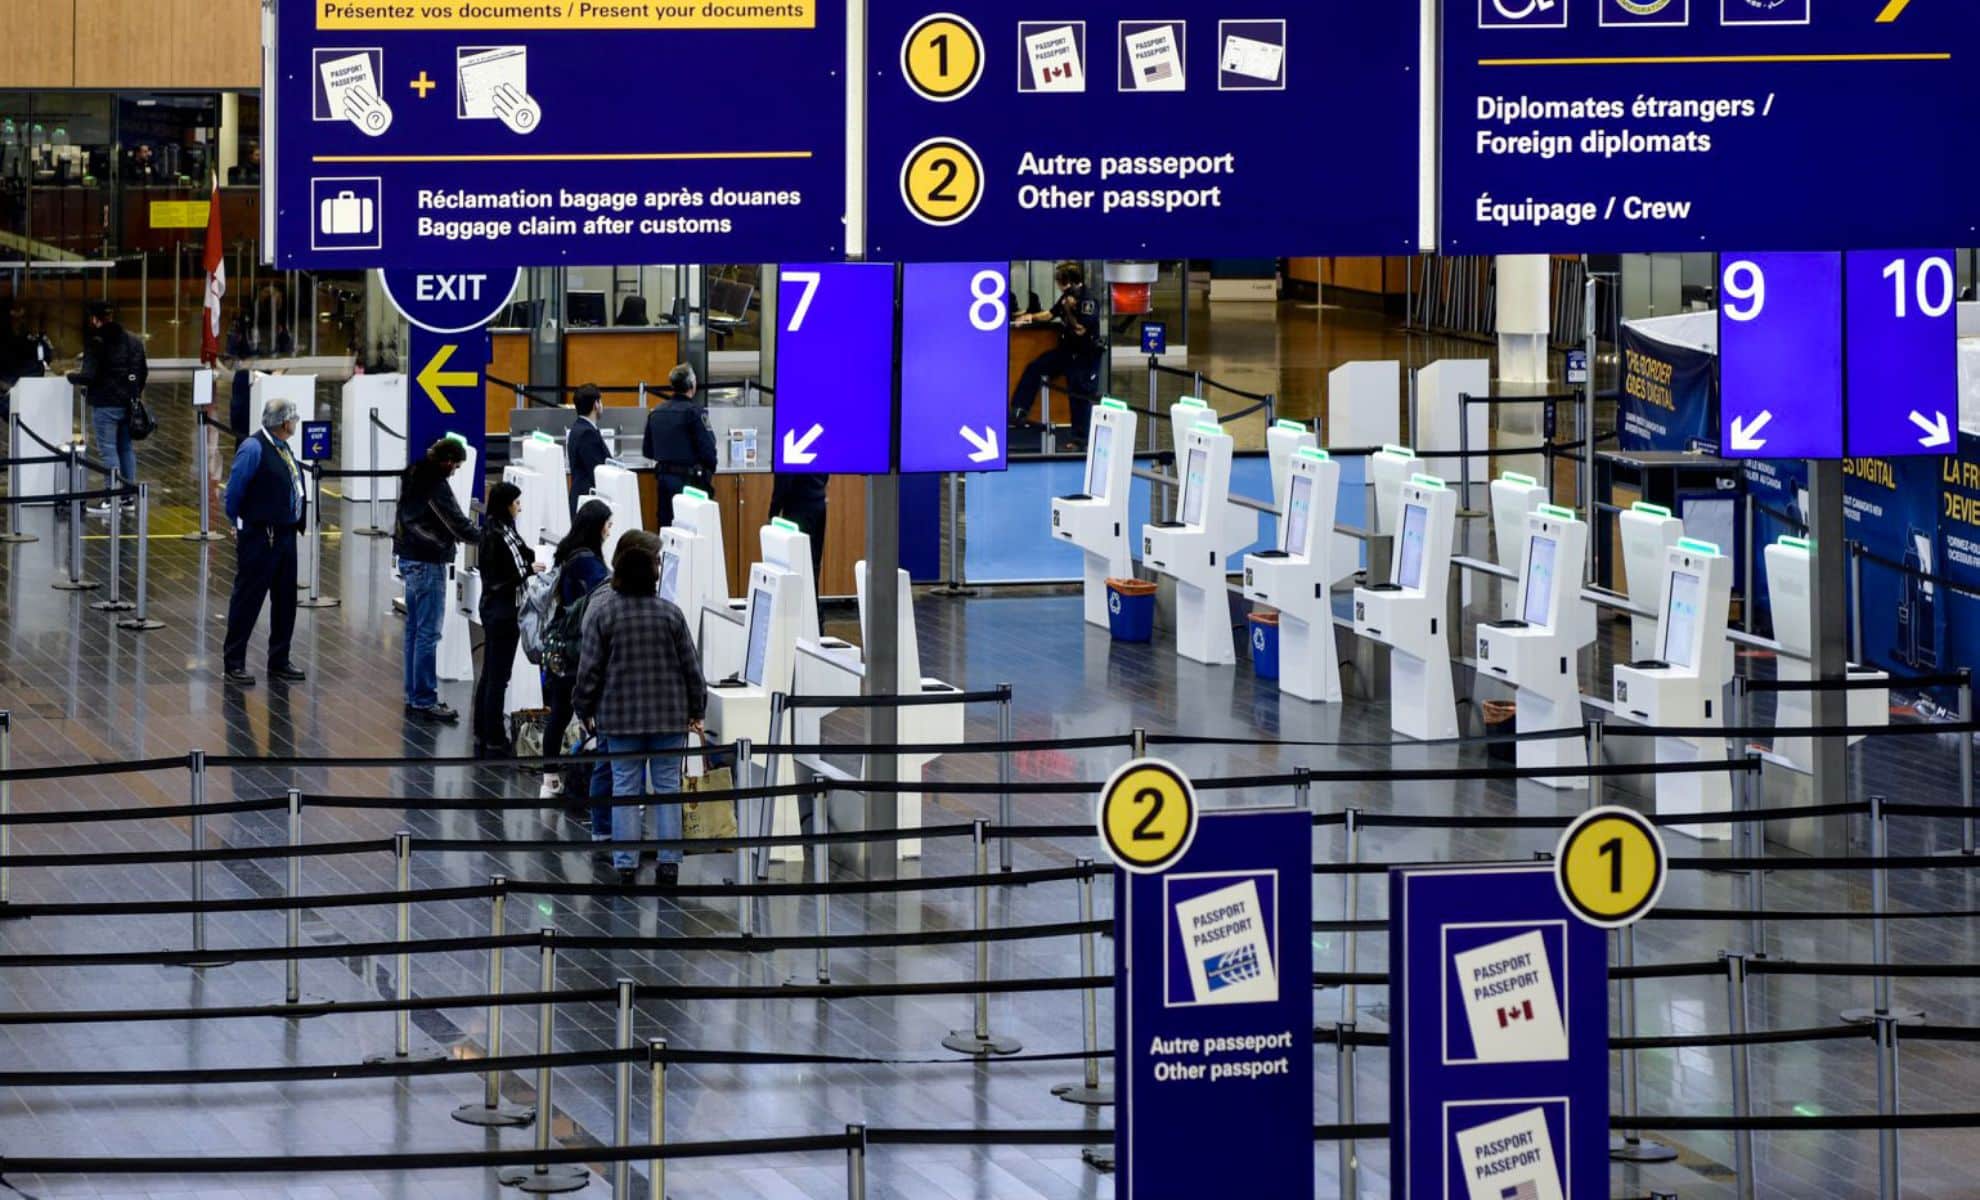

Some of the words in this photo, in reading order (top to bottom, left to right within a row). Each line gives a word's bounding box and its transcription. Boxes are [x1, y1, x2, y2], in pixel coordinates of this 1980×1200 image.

[324, 3, 414, 18] Présentez
[421, 6, 453, 18] vos
[459, 3, 562, 18] documents
[567, 3, 574, 17] /
[580, 3, 649, 17] Present
[656, 5, 695, 20] your
[702, 2, 804, 17] documents
[929, 34, 948, 77] 1
[1034, 37, 1066, 51] PASSPORT
[1035, 46, 1070, 60] PASSEPORT
[1135, 36, 1167, 51] PASSPORT
[1135, 45, 1171, 60] PASSEPORT
[330, 64, 363, 79] PASSPORT
[330, 73, 367, 88] PASSEPORT
[1476, 96, 1624, 124] Diplomates
[1631, 94, 1755, 122] étrangers
[1762, 93, 1775, 116] /
[1476, 130, 1572, 158] Foreign
[1580, 129, 1711, 158] diplomats
[927, 158, 958, 202] 2
[1017, 152, 1092, 176] Autre
[1101, 153, 1234, 180] passeport
[417, 189, 552, 209] Réclamation
[560, 188, 638, 212] bagage
[644, 187, 703, 211] après
[710, 187, 801, 206] douanes
[1018, 185, 1095, 209] Other
[1103, 186, 1221, 213] passport
[1476, 192, 1597, 226] Équipage
[1604, 196, 1616, 220] /
[1623, 196, 1691, 220] Crew
[417, 217, 512, 240] Baggage
[518, 216, 577, 235] claim
[583, 215, 633, 235] after
[640, 216, 732, 234] customs
[416, 274, 487, 301] EXIT
[969, 270, 1006, 331] 8
[1723, 260, 1765, 322] 9
[1882, 256, 1954, 318] 10
[781, 272, 821, 332] 7
[1856, 457, 1896, 489] DIGITAL
[1943, 456, 1961, 485] LA
[1963, 462, 1980, 490] FR
[1132, 787, 1164, 841] 2
[1599, 837, 1622, 894] 1
[1193, 901, 1246, 929] PASSPORT
[1193, 918, 1252, 947] PASSEPORT
[1473, 953, 1531, 981] PASSPORT
[1474, 970, 1539, 1001] PASSEPORT
[1150, 1036, 1199, 1055] Autre
[1204, 1031, 1292, 1056] passeport
[1154, 1062, 1206, 1081] Other
[1211, 1057, 1288, 1082] passport
[1475, 1130, 1533, 1160] PASSPORT
[1476, 1148, 1541, 1180] PASSEPORT
